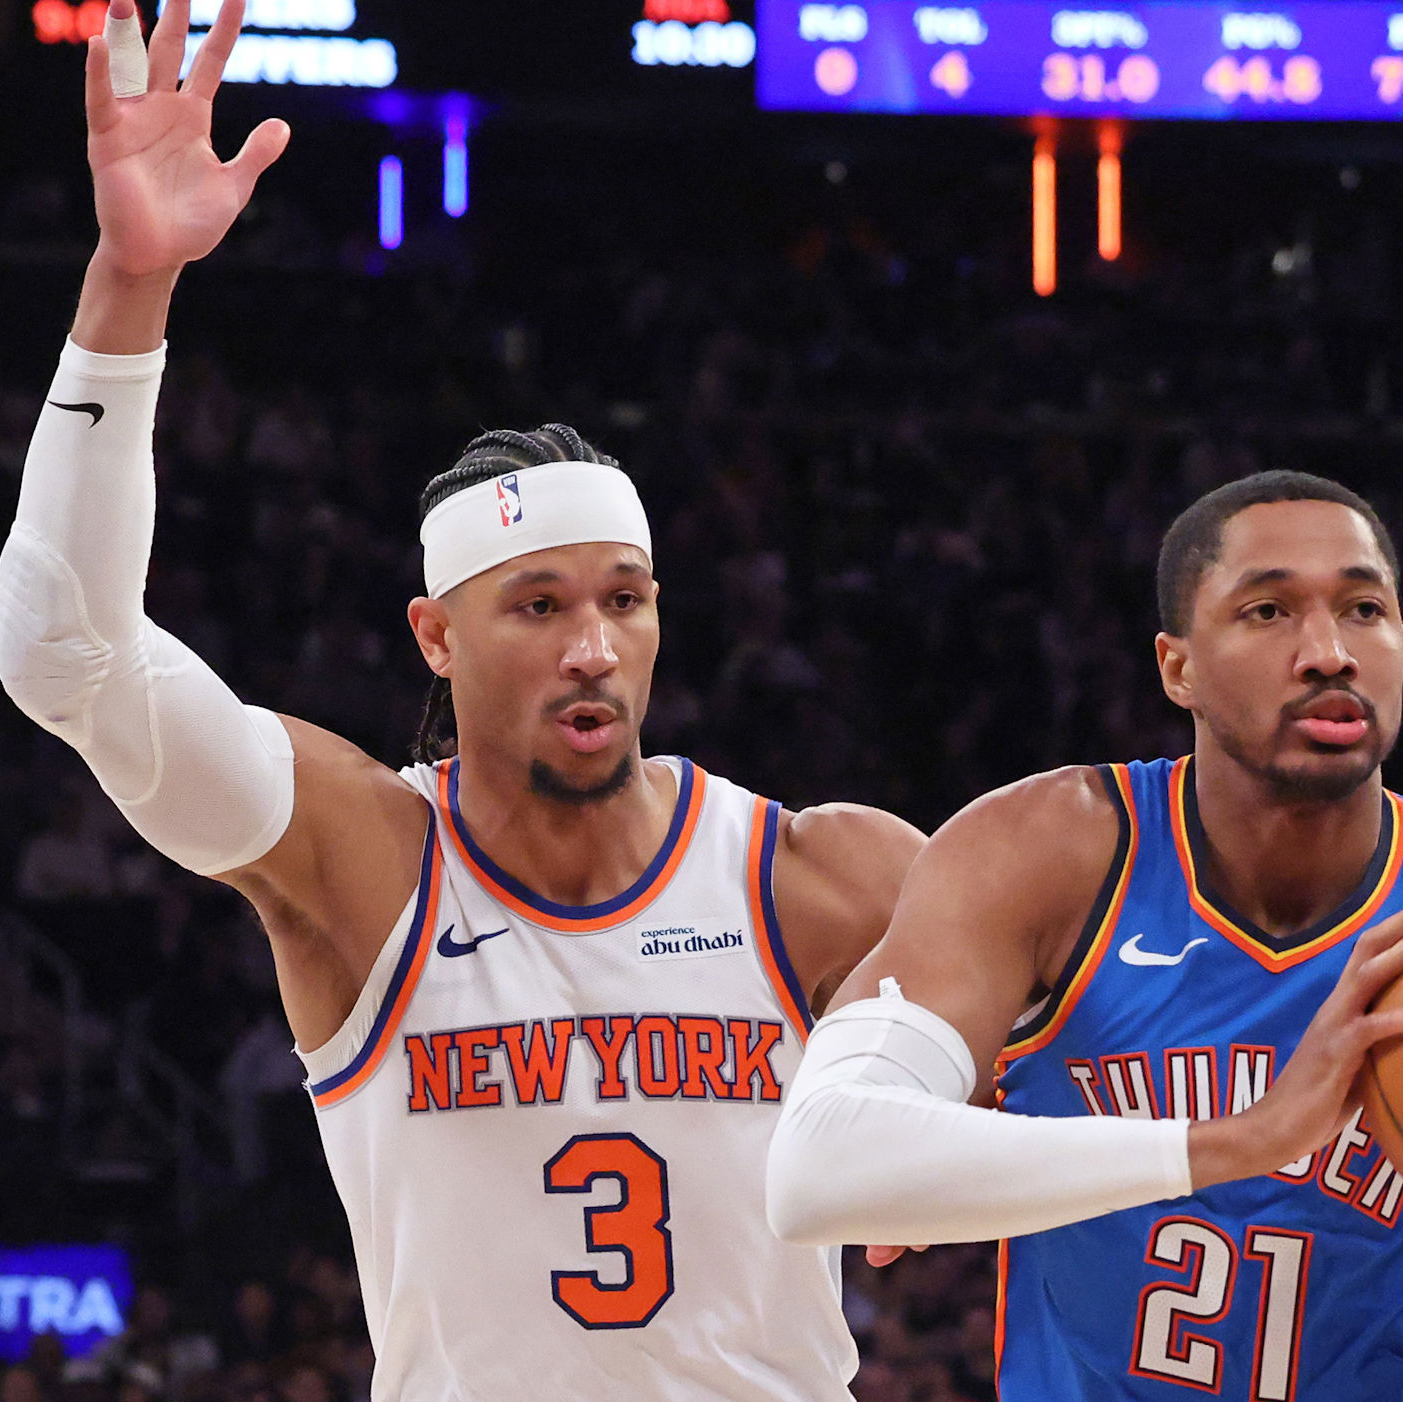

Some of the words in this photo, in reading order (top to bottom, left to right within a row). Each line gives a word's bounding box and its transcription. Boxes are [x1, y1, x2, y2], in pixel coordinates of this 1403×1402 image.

[641, 926, 695, 939] experience
[641, 938, 681, 956] abu
[403, 1018, 575, 1115] NEW
[578, 1011, 785, 1104] YORK
[542, 1131, 675, 1331] 3
